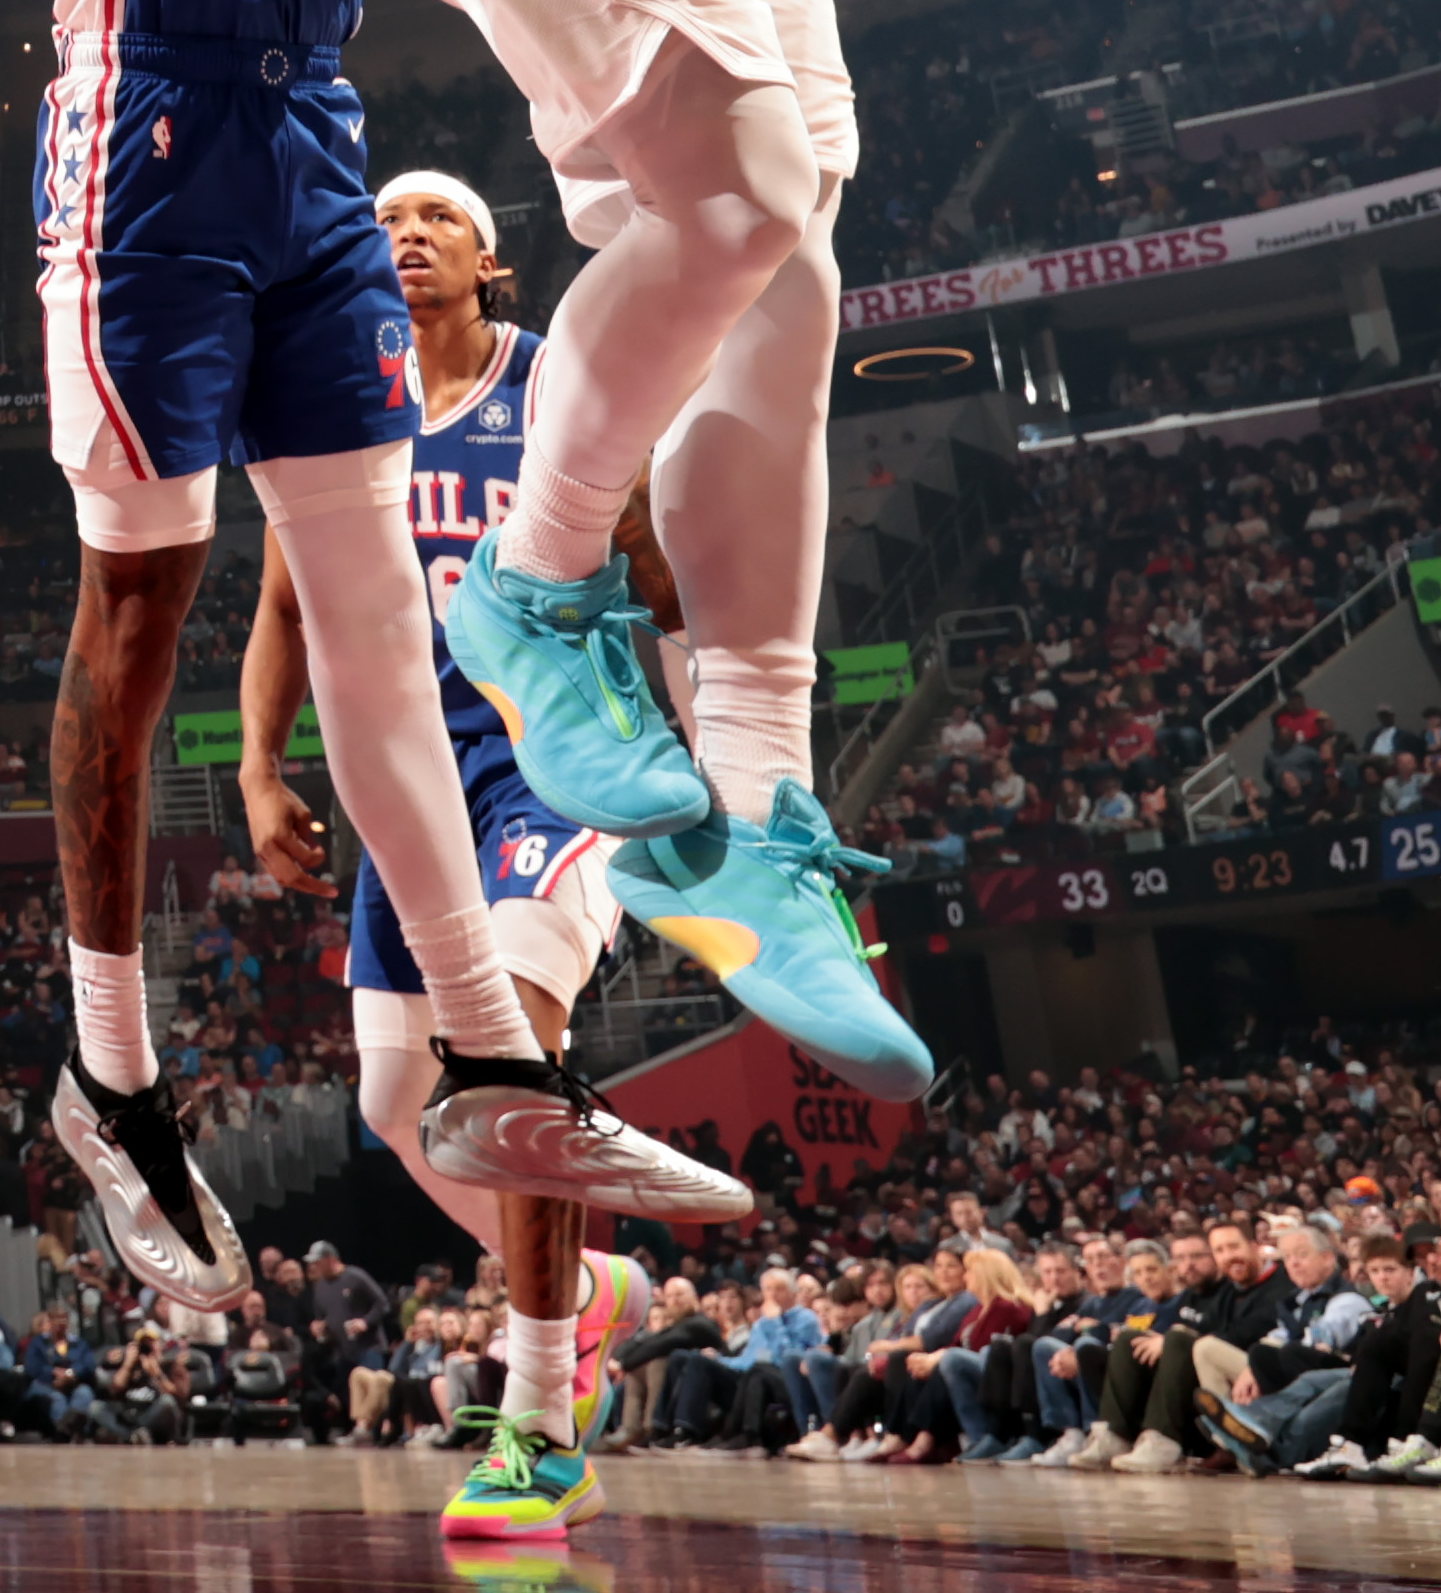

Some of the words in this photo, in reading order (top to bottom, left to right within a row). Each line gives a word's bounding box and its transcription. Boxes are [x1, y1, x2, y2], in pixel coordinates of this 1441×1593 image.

[1030, 226, 1230, 297] THREES
[1366, 189, 1441, 226] DAVE
[465, 432, 524, 446] crypto.com
[497, 834, 548, 881] 76
[1211, 850, 1294, 893] 9:23
[1327, 836, 1370, 872] 4.7
[1390, 826, 1441, 872] 25
[1057, 871, 1109, 911] 33
[1131, 867, 1169, 896] 2Q
[946, 902, 964, 927] 0
[794, 1096, 880, 1150] GEEK
